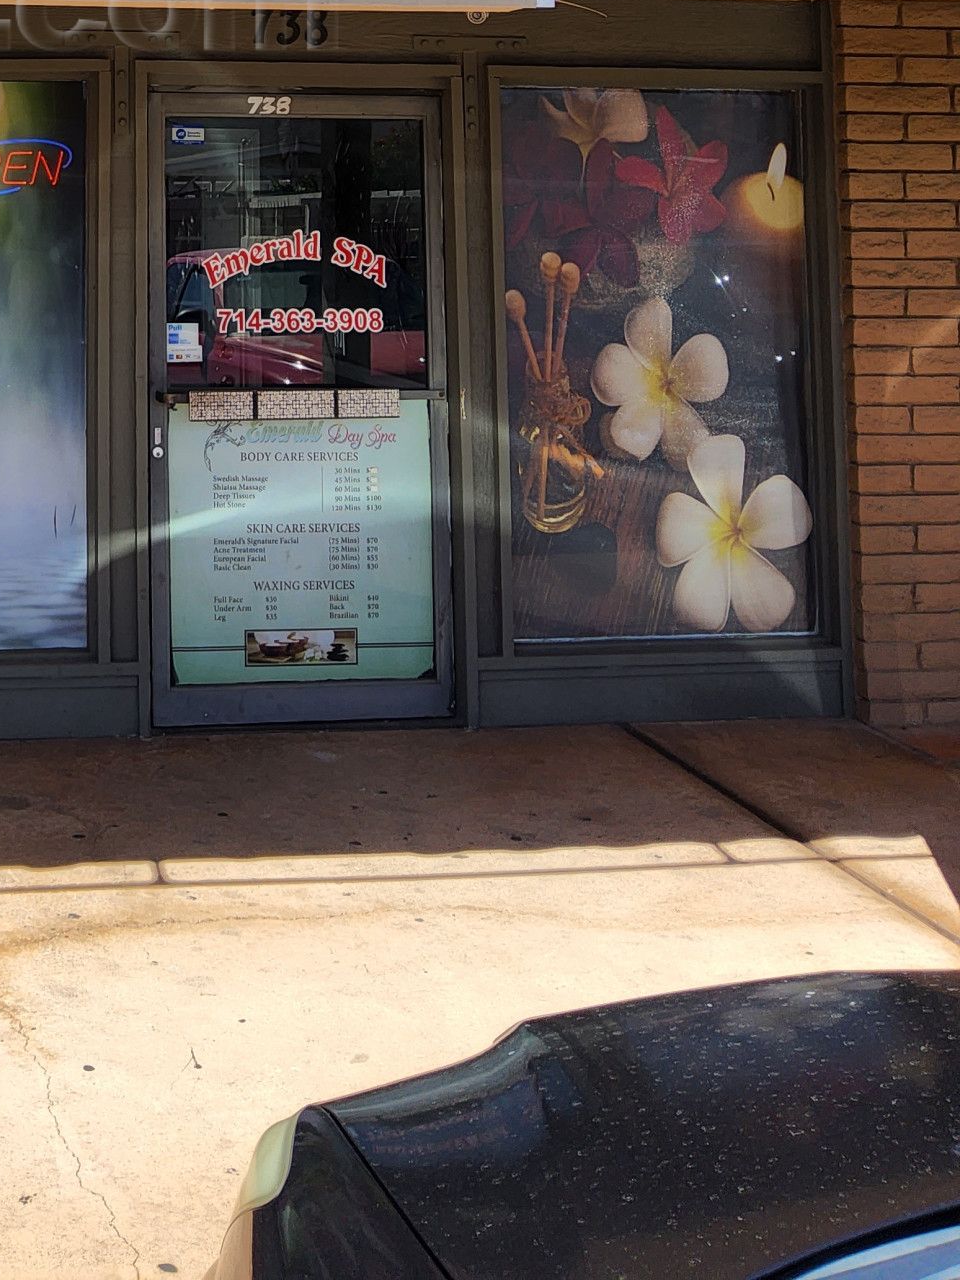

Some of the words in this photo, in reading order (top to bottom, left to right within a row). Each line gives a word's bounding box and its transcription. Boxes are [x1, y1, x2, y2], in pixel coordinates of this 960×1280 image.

[251, 9, 329, 45] 738
[247, 96, 291, 115] 738
[201, 229, 322, 289] Emerald
[331, 236, 387, 288] SPA
[216, 308, 383, 334] 714-363-3908
[327, 423, 365, 450] Day
[365, 423, 397, 450] Spa
[240, 451, 272, 462] BODY
[274, 451, 305, 462] CARE
[307, 451, 359, 462] SERVICES
[212, 475, 239, 483] Swedish
[241, 475, 269, 484] Massage
[239, 483, 266, 493] Massage
[213, 492, 231, 501] Deep
[246, 523, 274, 534] SKIN
[275, 523, 306, 534] CARE
[308, 522, 361, 534] SERVICES
[246, 537, 279, 547] Signature
[280, 537, 299, 545] Facial
[340, 536, 361, 546] Mins)
[366, 536, 379, 545] $70
[232, 546, 266, 554] Treatment
[340, 545, 361, 554] Mins)
[213, 555, 246, 564] European
[247, 555, 267, 563] Facial
[340, 554, 361, 563] Mins)
[232, 564, 252, 572] Clean
[340, 563, 361, 572] Mins)
[253, 580, 300, 592] WAXING
[302, 579, 356, 591] SERVICES
[213, 596, 227, 604] Full
[228, 596, 244, 604] Face
[329, 593, 350, 602] Bikini
[213, 605, 235, 613] Under
[236, 605, 253, 613] Arm
[329, 602, 345, 610] Back
[214, 614, 227, 623] Leg
[329, 611, 359, 620] Brazilian
